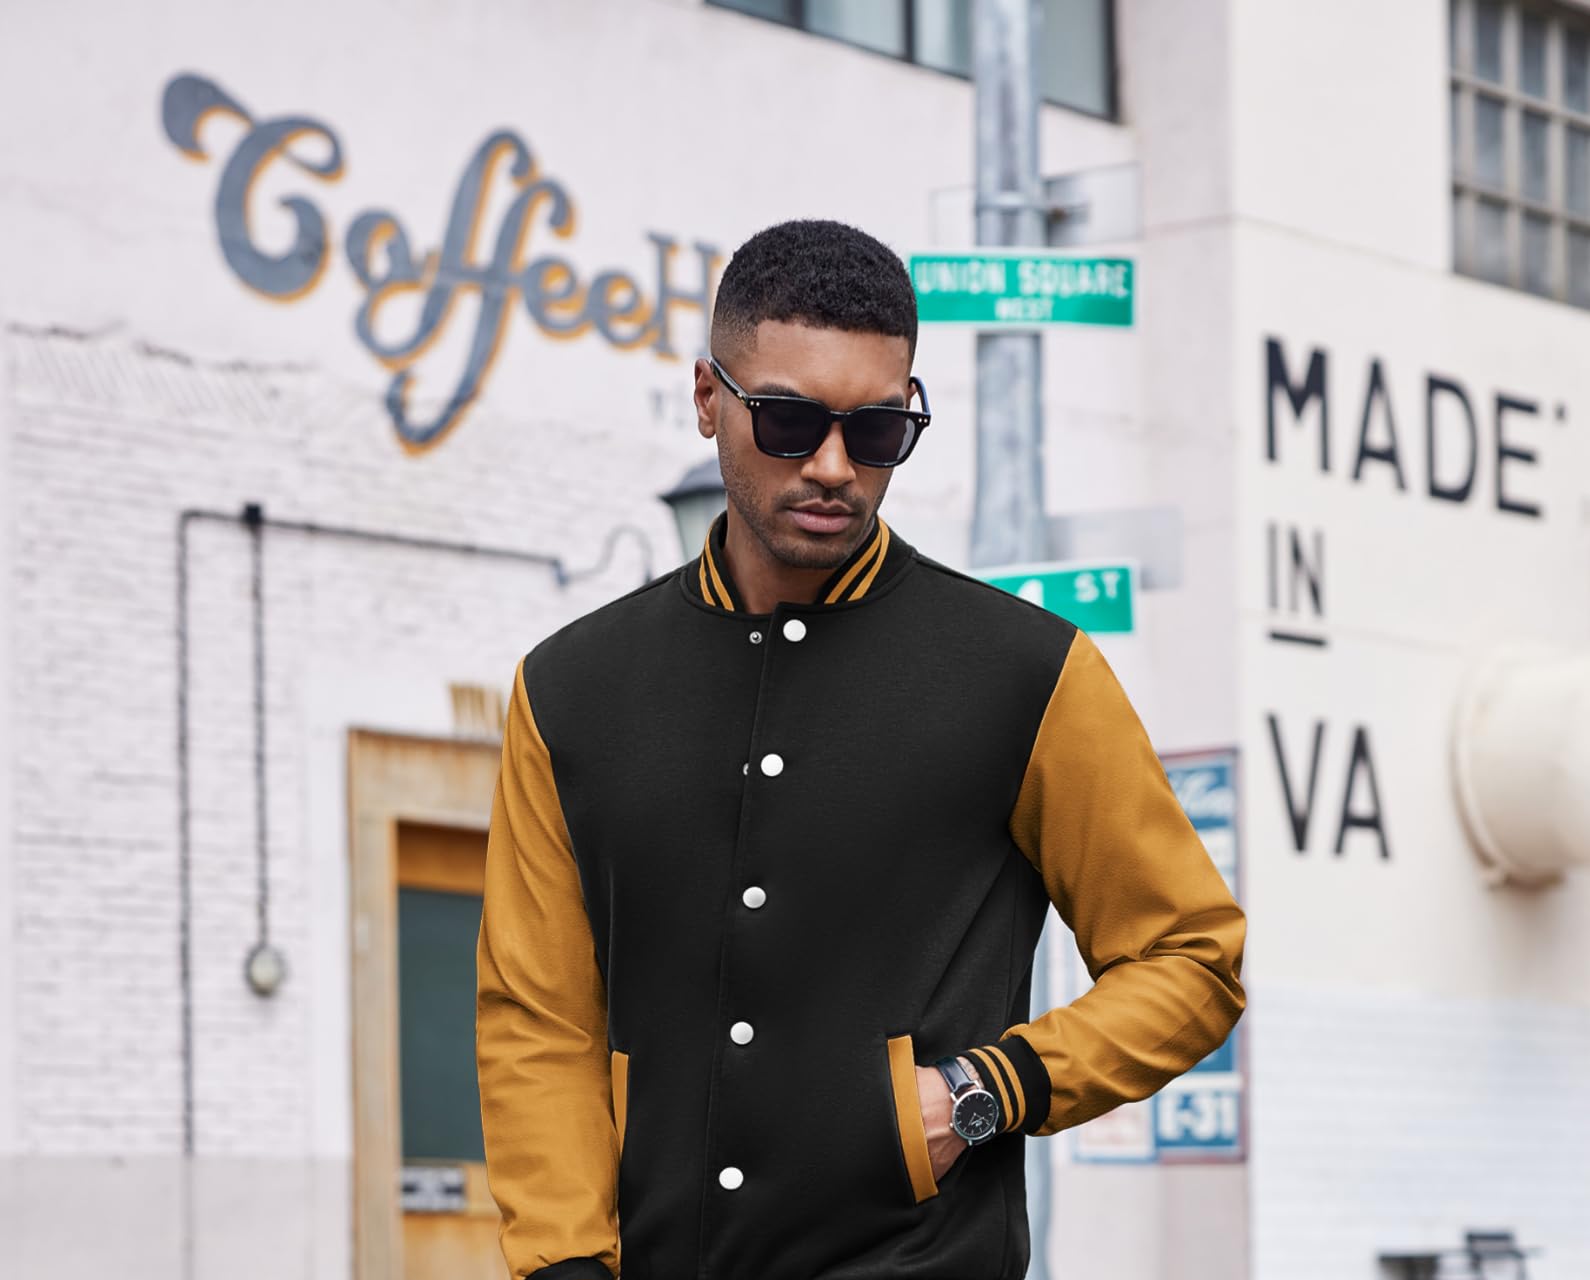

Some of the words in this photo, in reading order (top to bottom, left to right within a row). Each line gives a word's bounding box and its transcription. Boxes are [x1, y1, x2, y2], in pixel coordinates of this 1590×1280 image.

[914, 261, 1006, 294] UNION
[1018, 261, 1128, 298] SQUARE
[994, 298, 1054, 321] WEST
[1074, 570, 1121, 603] ST
[1267, 521, 1325, 617] IN
[1266, 711, 1391, 862] VA
